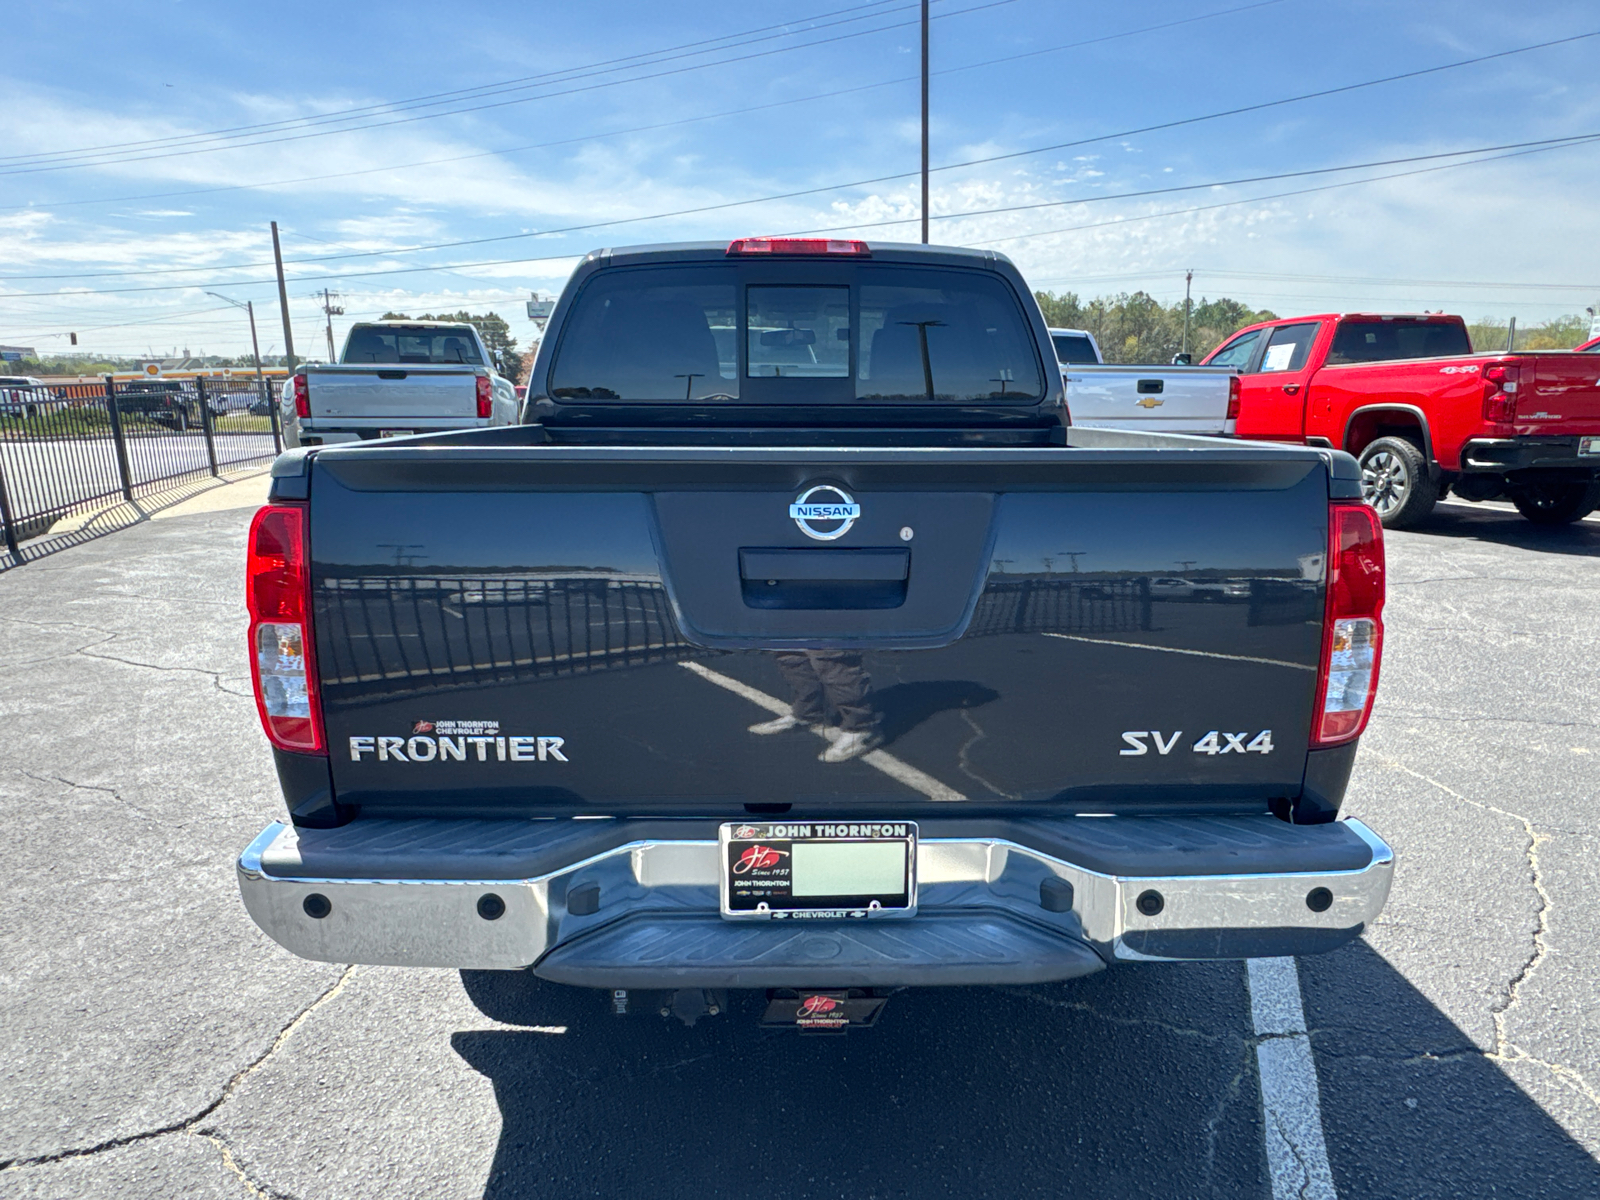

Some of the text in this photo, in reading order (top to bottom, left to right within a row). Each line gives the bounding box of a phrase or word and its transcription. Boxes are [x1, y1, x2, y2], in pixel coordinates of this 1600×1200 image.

[797, 507, 853, 516] NISSAN
[349, 736, 569, 762] FRONTIER
[1119, 731, 1183, 756] SV
[766, 824, 906, 838] JOHN THORNTON
[792, 911, 847, 919] CHEVROLET
